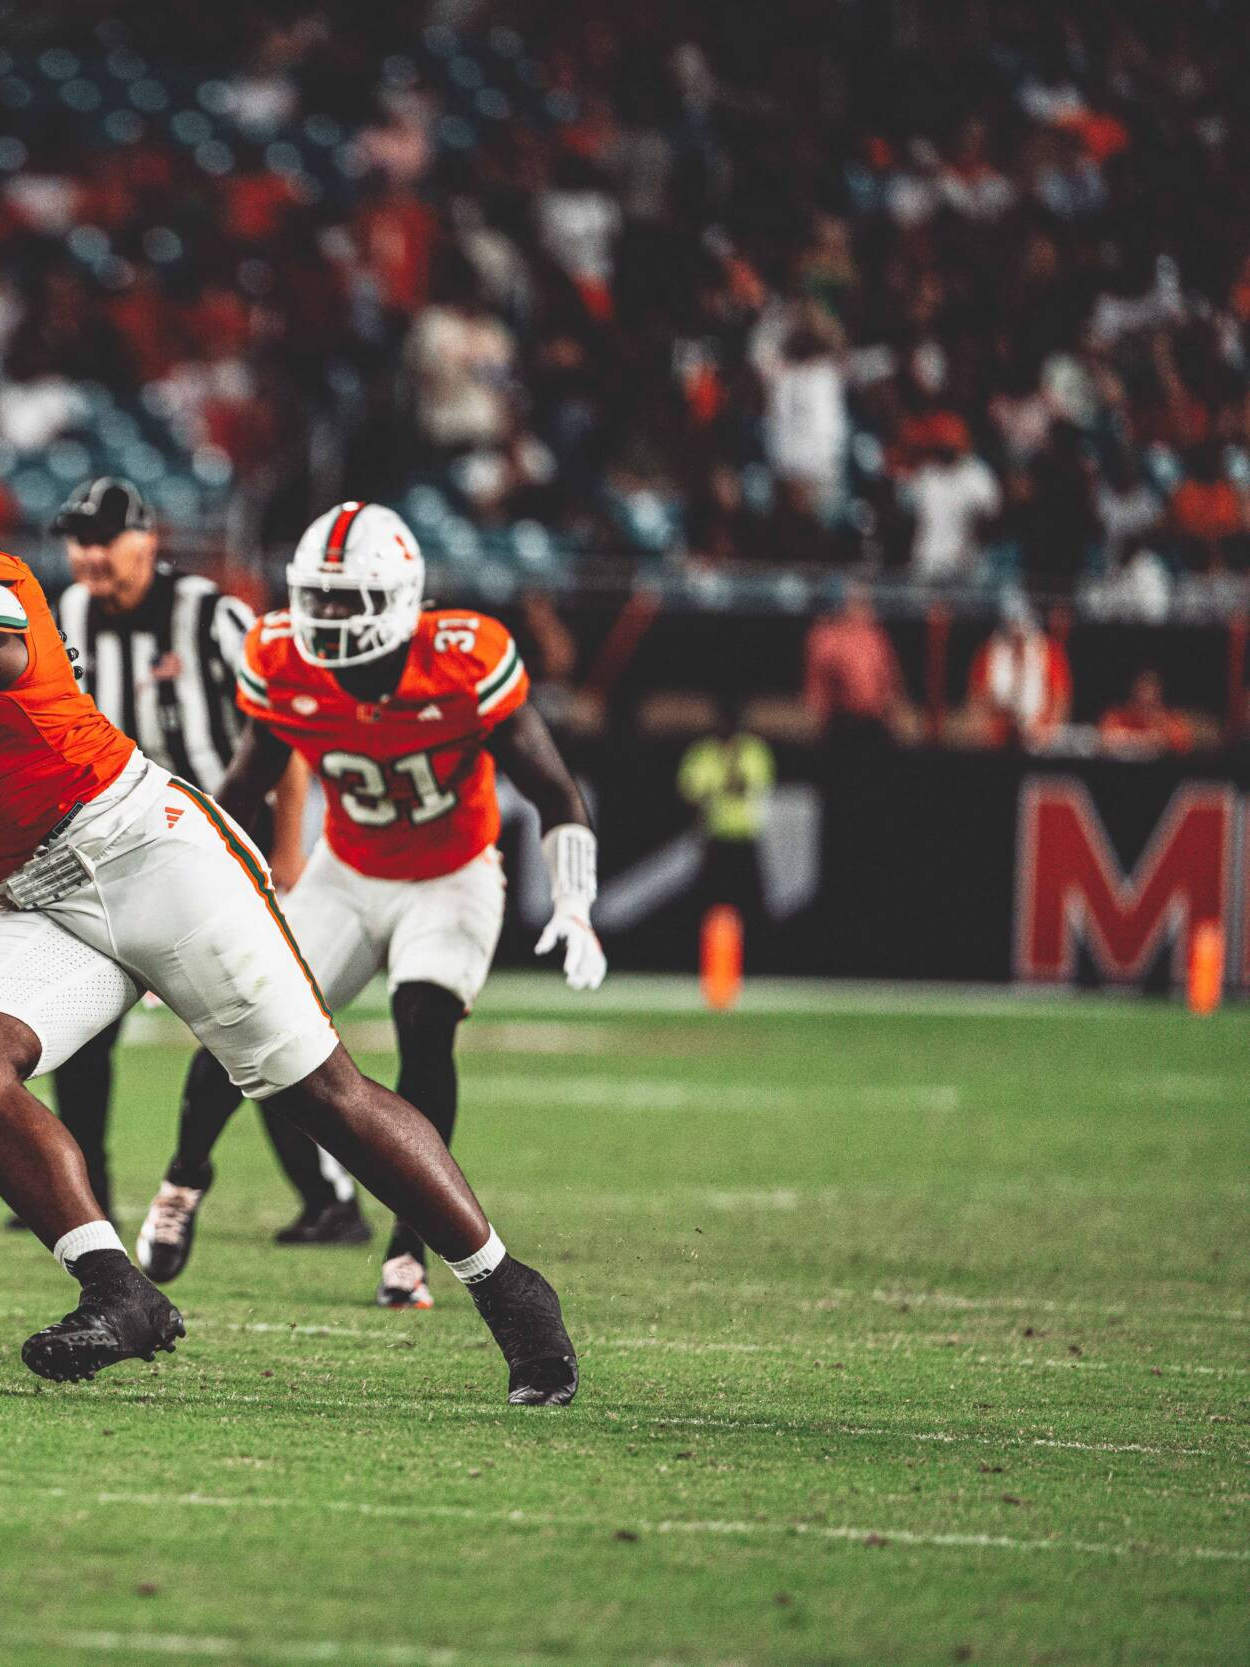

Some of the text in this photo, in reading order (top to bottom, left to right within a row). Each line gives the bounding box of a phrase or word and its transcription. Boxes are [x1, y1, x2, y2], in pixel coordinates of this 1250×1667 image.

[434, 616, 480, 653] 31
[322, 751, 456, 826] 31
[1015, 775, 1250, 988] M
